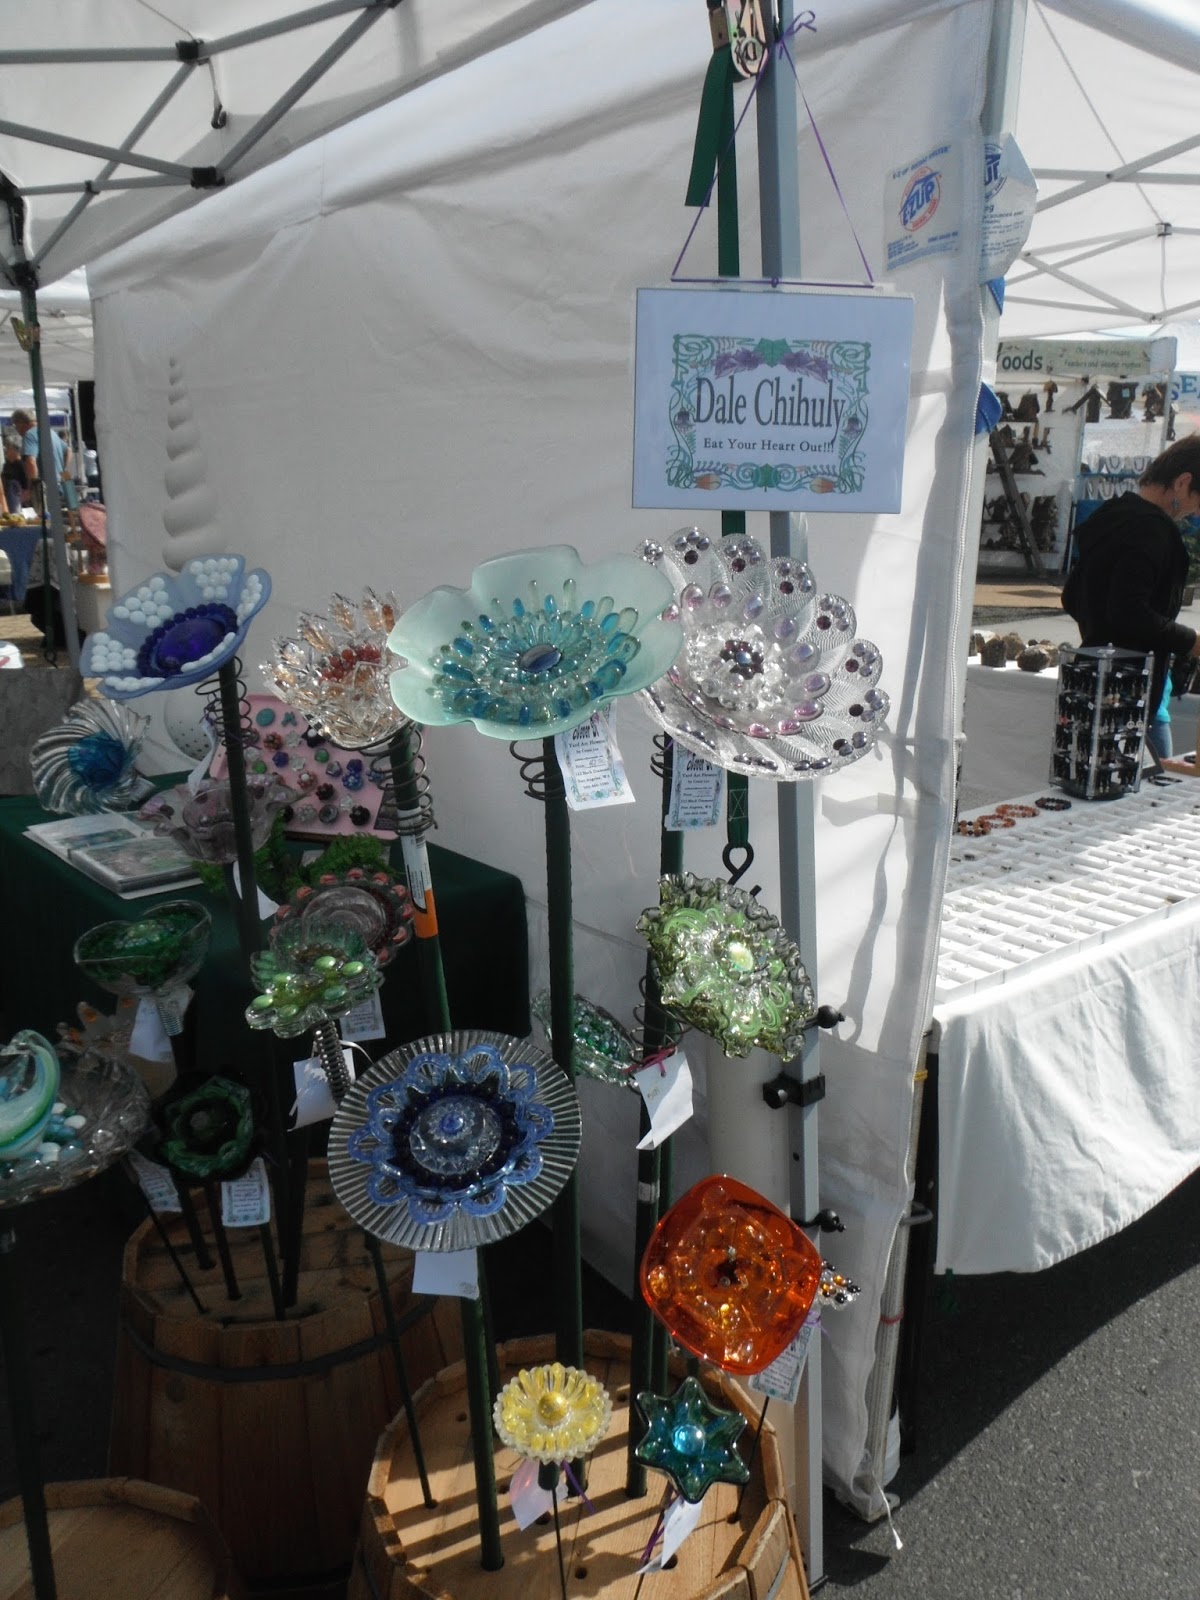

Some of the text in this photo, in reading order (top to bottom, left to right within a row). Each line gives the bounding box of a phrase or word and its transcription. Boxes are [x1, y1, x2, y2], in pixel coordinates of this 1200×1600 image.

[996, 342, 1043, 370] oods
[1170, 374, 1200, 400] SE
[693, 375, 846, 444] Dale Chihuly
[703, 437, 834, 453] Eat Your Heart Out!!!
